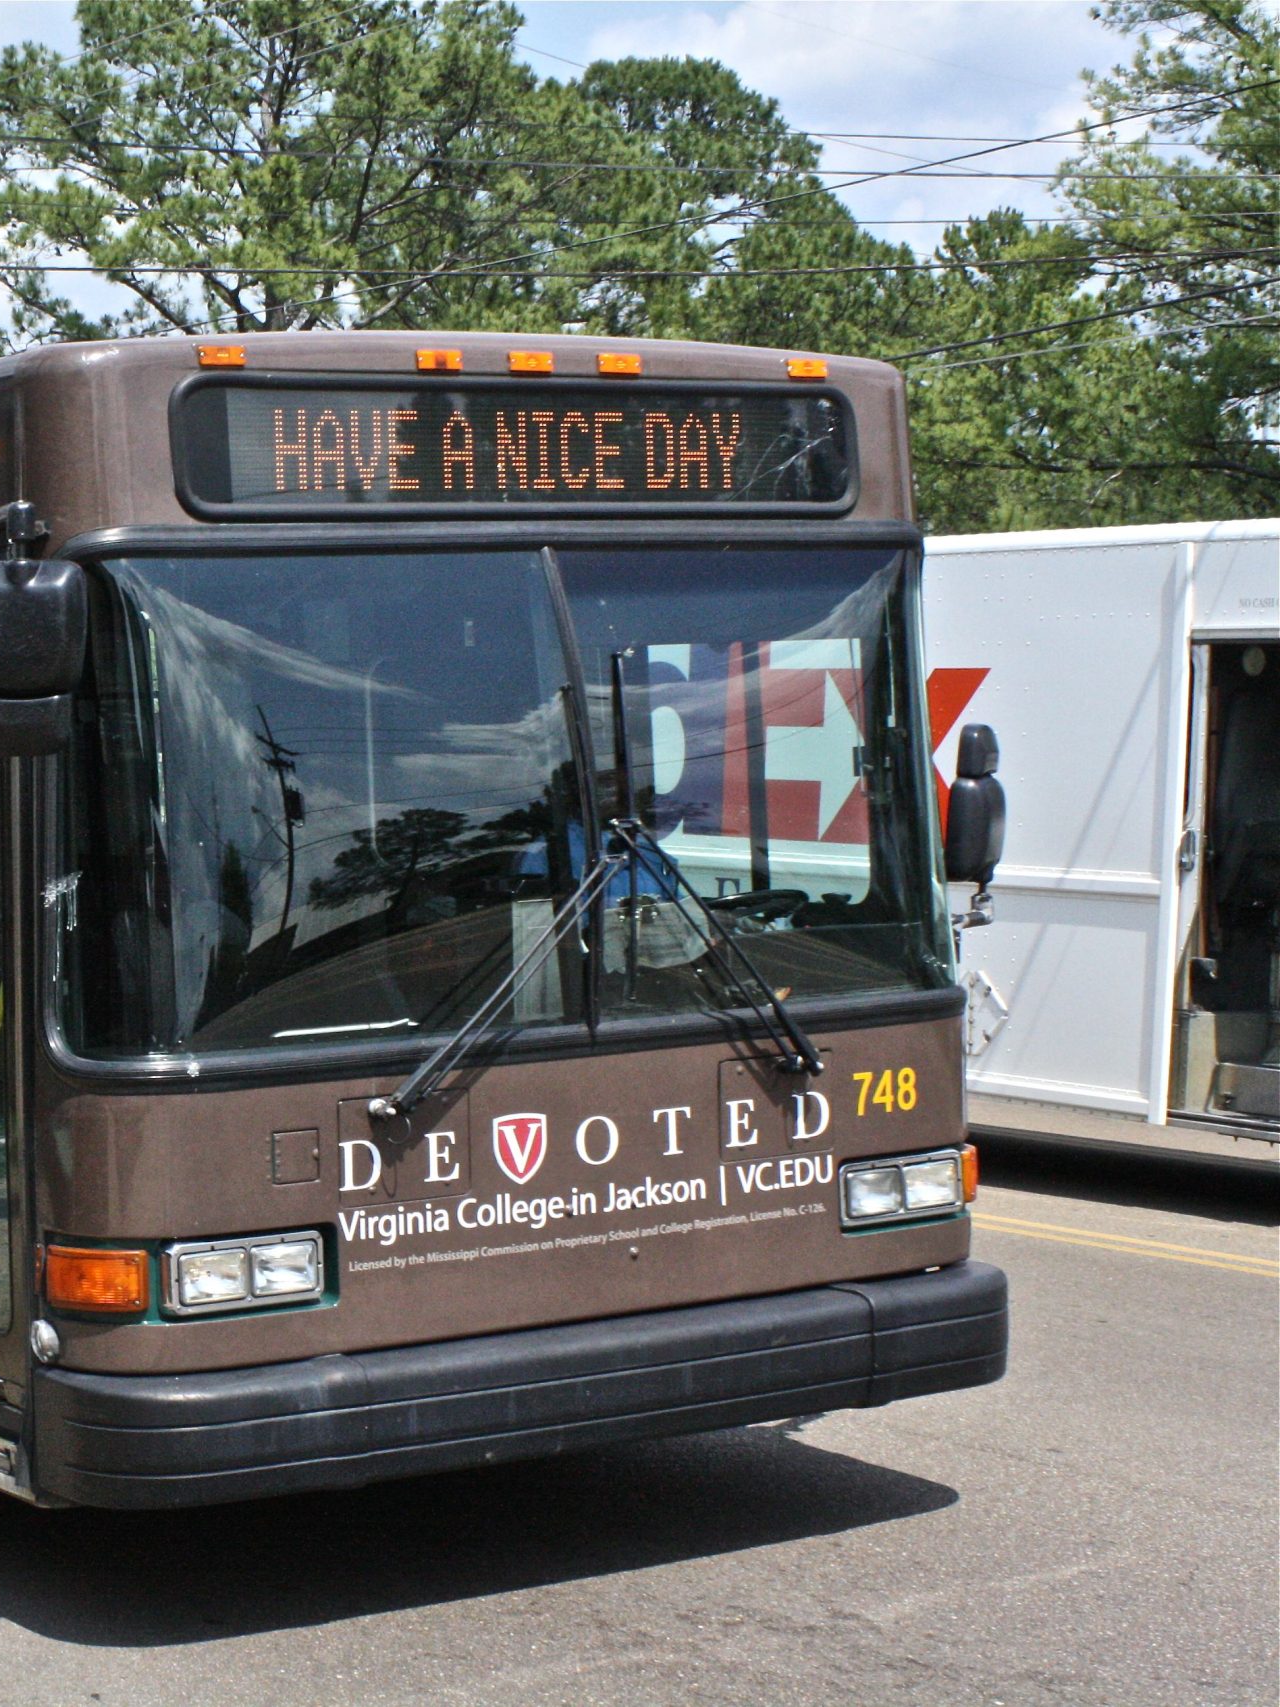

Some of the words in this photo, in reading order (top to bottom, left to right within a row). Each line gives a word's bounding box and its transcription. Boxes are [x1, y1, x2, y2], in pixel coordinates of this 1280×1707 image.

[274, 409, 420, 490] HAVE
[443, 410, 474, 490] A
[496, 411, 624, 490] NICE
[645, 412, 740, 490] DAY
[852, 1066, 918, 1118] 748
[338, 1090, 831, 1193] DEVOTED
[338, 1203, 450, 1246] Virginia
[457, 1193, 565, 1230] College
[571, 1187, 597, 1215] in
[603, 1176, 707, 1213] Jackson
[736, 1154, 833, 1194] VC.EDU
[348, 1254, 392, 1272] Licensed
[394, 1253, 408, 1270] by
[409, 1251, 425, 1265] the
[427, 1247, 479, 1263] Mississippi
[481, 1242, 540, 1258] Commission
[541, 1240, 554, 1251] on
[555, 1231, 608, 1250] Proprietary
[609, 1227, 640, 1242] School
[641, 1224, 659, 1237] and
[660, 1220, 693, 1235] College
[694, 1214, 749, 1231] Registration,
[750, 1209, 783, 1223] License
[783, 1206, 798, 1218] No.
